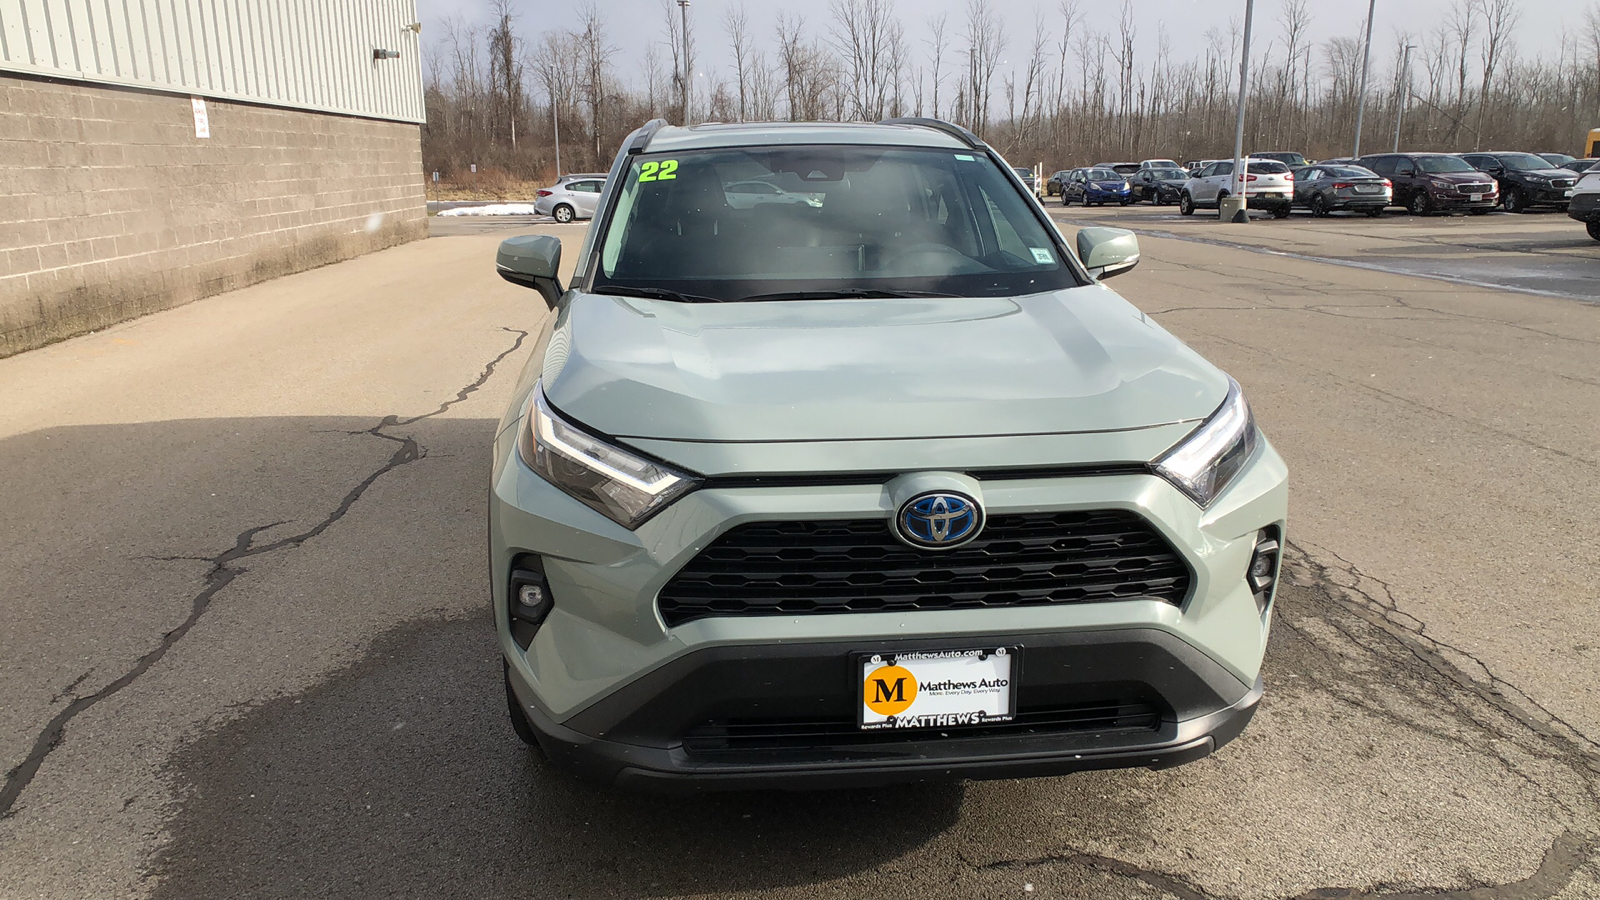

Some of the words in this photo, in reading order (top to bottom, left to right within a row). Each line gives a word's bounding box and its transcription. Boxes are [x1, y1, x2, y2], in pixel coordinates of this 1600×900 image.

[639, 160, 678, 182] 22
[895, 650, 983, 661] MatthewsAuto.com
[872, 678, 907, 703] M
[919, 680, 977, 691] Matthews
[979, 678, 1008, 688] Auto
[895, 713, 979, 728] MATTHEWS
